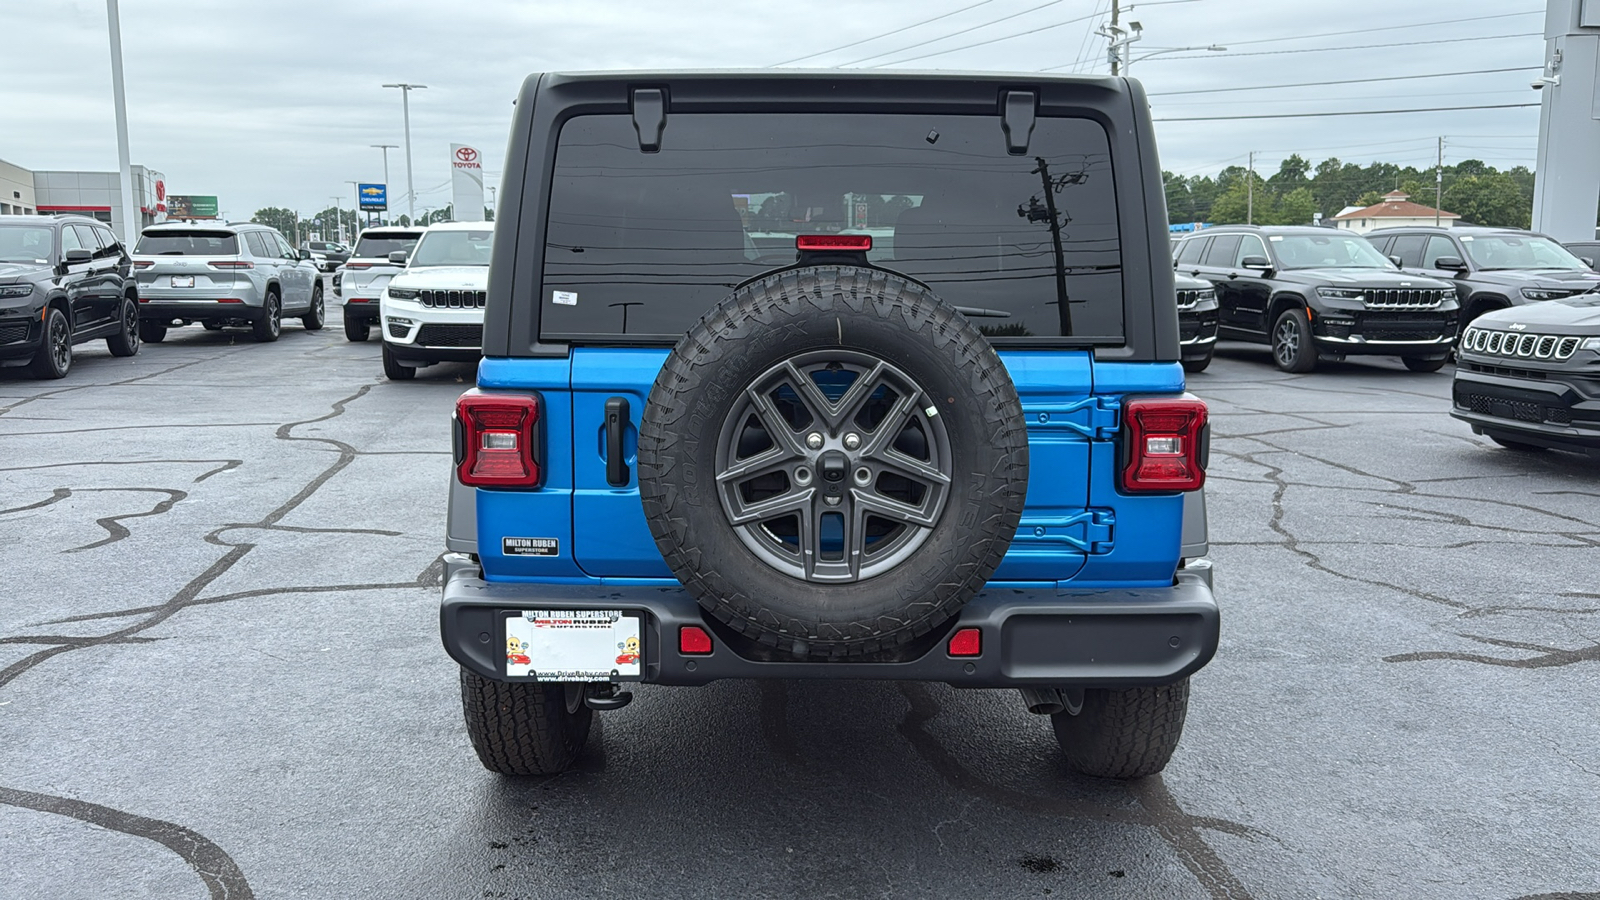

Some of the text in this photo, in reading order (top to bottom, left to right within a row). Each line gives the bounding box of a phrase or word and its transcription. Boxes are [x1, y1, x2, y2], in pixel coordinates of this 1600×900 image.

[896, 473, 986, 601] NEXEN
[505, 538, 556, 548] MILTON RUBEN
[521, 610, 623, 618] MILTON RUBEN SUPERSTORE
